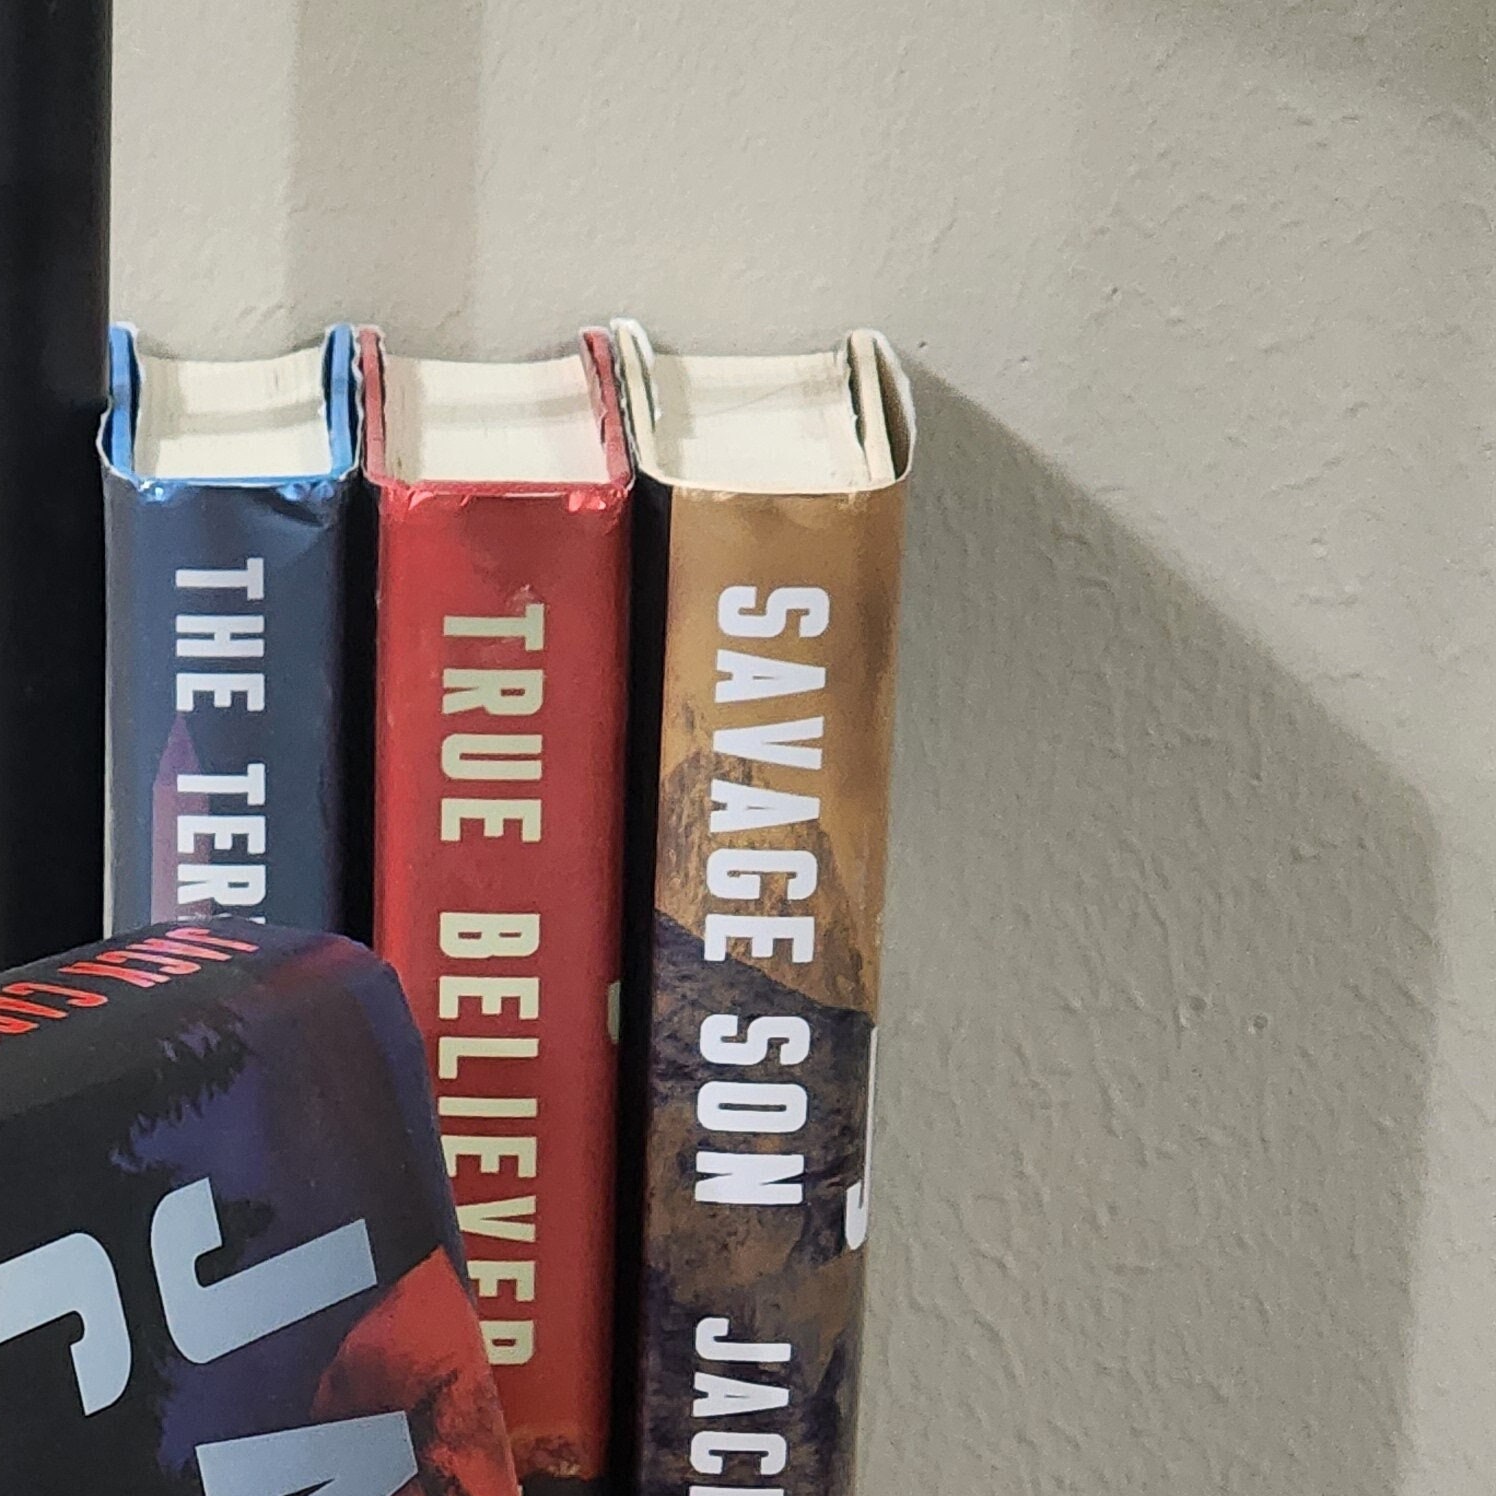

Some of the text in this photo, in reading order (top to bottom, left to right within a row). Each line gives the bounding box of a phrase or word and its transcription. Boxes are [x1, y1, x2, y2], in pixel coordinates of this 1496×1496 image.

[176, 559, 265, 924] THE TER
[441, 604, 545, 842] TRUE
[703, 586, 829, 962] SAVAGE
[58, 927, 260, 988] JACK
[695, 1015, 810, 1204] SON
